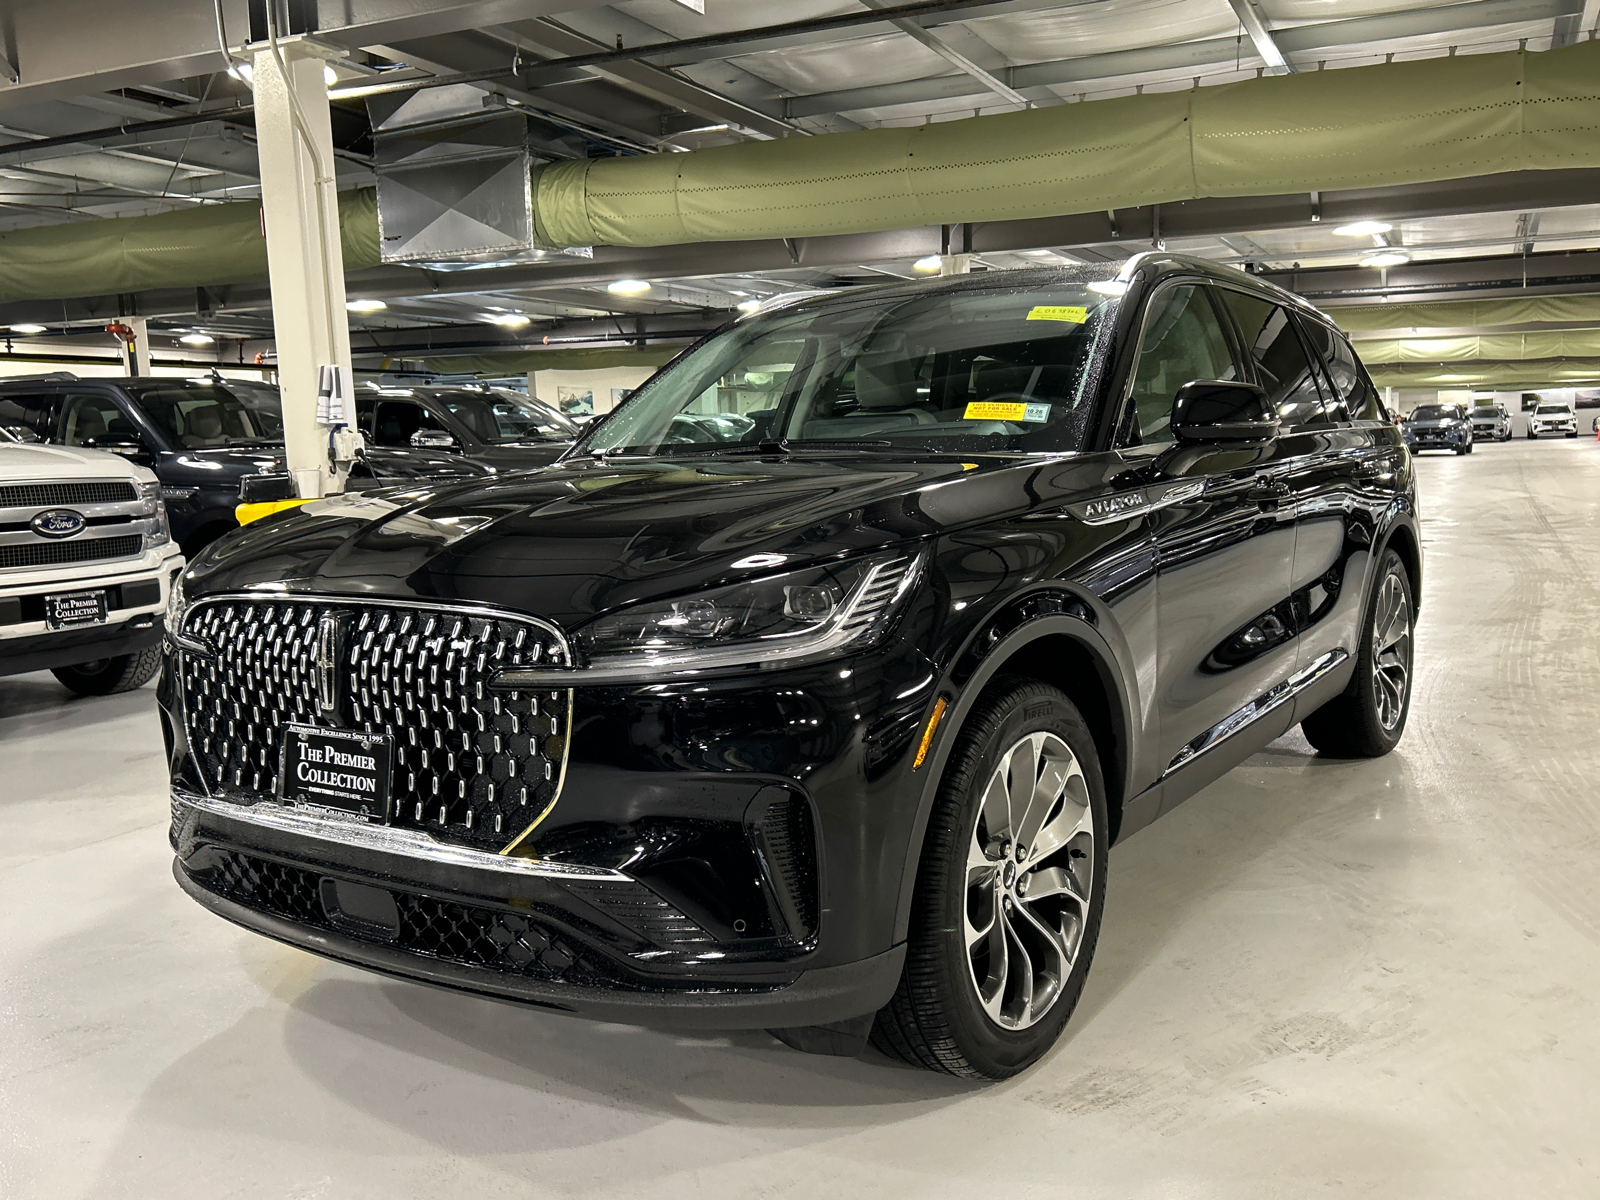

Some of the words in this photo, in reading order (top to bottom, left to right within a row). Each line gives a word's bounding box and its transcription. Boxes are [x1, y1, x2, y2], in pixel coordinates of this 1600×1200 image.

[1085, 493, 1143, 517] AVIATOR
[48, 516, 74, 530] Ford
[53, 601, 70, 610] THE
[70, 600, 98, 608] PREMIER
[55, 607, 99, 618] COLLECTION
[1023, 701, 1053, 722] PIRELLI
[288, 724, 320, 735] AUTOMOTIVE
[320, 728, 352, 739] EXCELLENCE
[352, 732, 368, 741] SINCE
[368, 734, 384, 744] 1995
[297, 741, 323, 763] THE
[324, 745, 376, 771] PREMIER
[296, 761, 376, 793] COLLECTION
